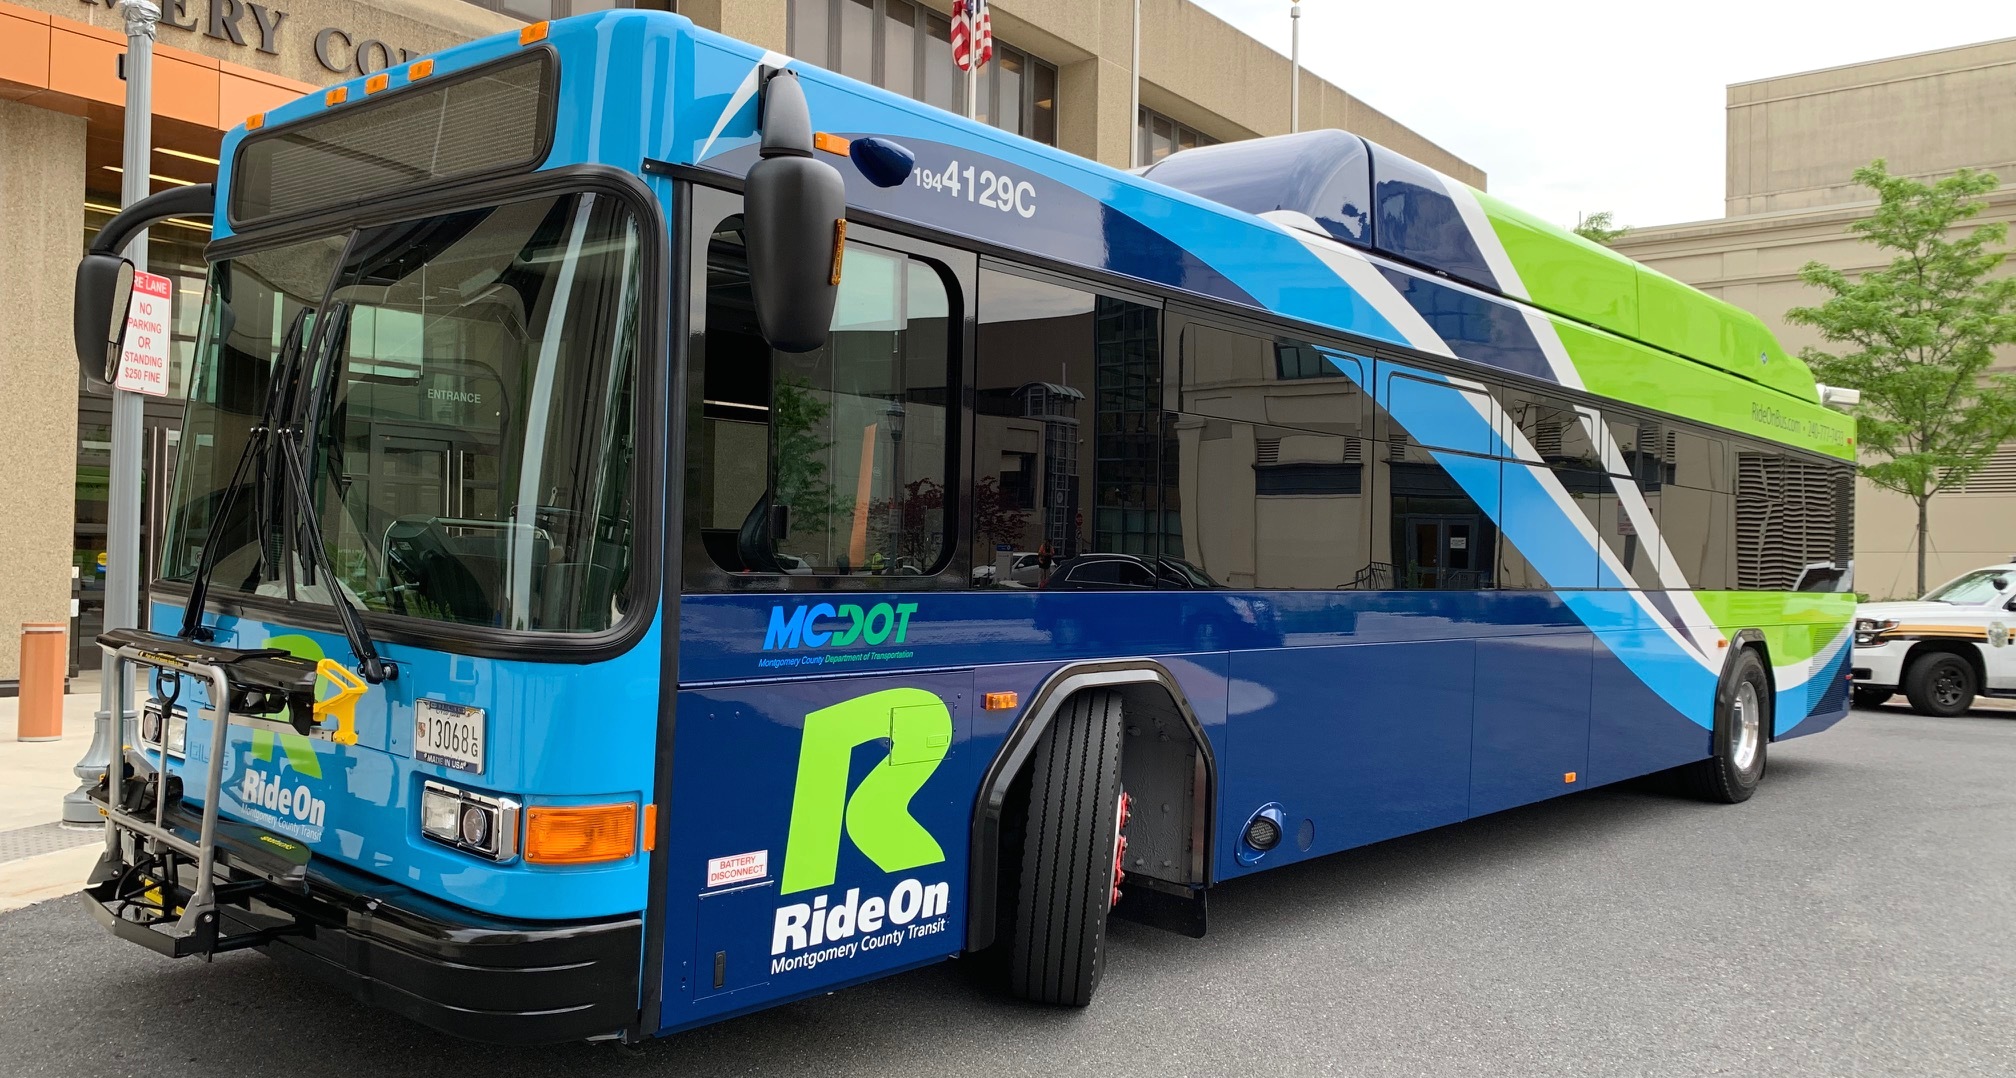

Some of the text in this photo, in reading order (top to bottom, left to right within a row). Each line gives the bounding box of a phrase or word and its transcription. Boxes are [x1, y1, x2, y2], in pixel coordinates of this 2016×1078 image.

[145, 277, 167, 295] LANE
[139, 302, 152, 316] NO
[128, 317, 162, 334] PARKING
[138, 336, 151, 349] OR
[124, 351, 163, 368] STANDING
[125, 367, 161, 383] $250 FINE
[427, 388, 482, 404] ENTRANCE
[1751, 401, 1801, 433] RideOnBus.com
[762, 602, 919, 650] MCDOT
[758, 650, 914, 668] Montgomery County Department of Transportation
[428, 717, 469, 754] 13068
[427, 754, 464, 770] MADE IN USA
[240, 803, 322, 842] Montgomery County Transit
[720, 856, 756, 870] BATTERY
[711, 864, 764, 881] DISCONNECT
[771, 918, 946, 975] Montgomery County Transit
